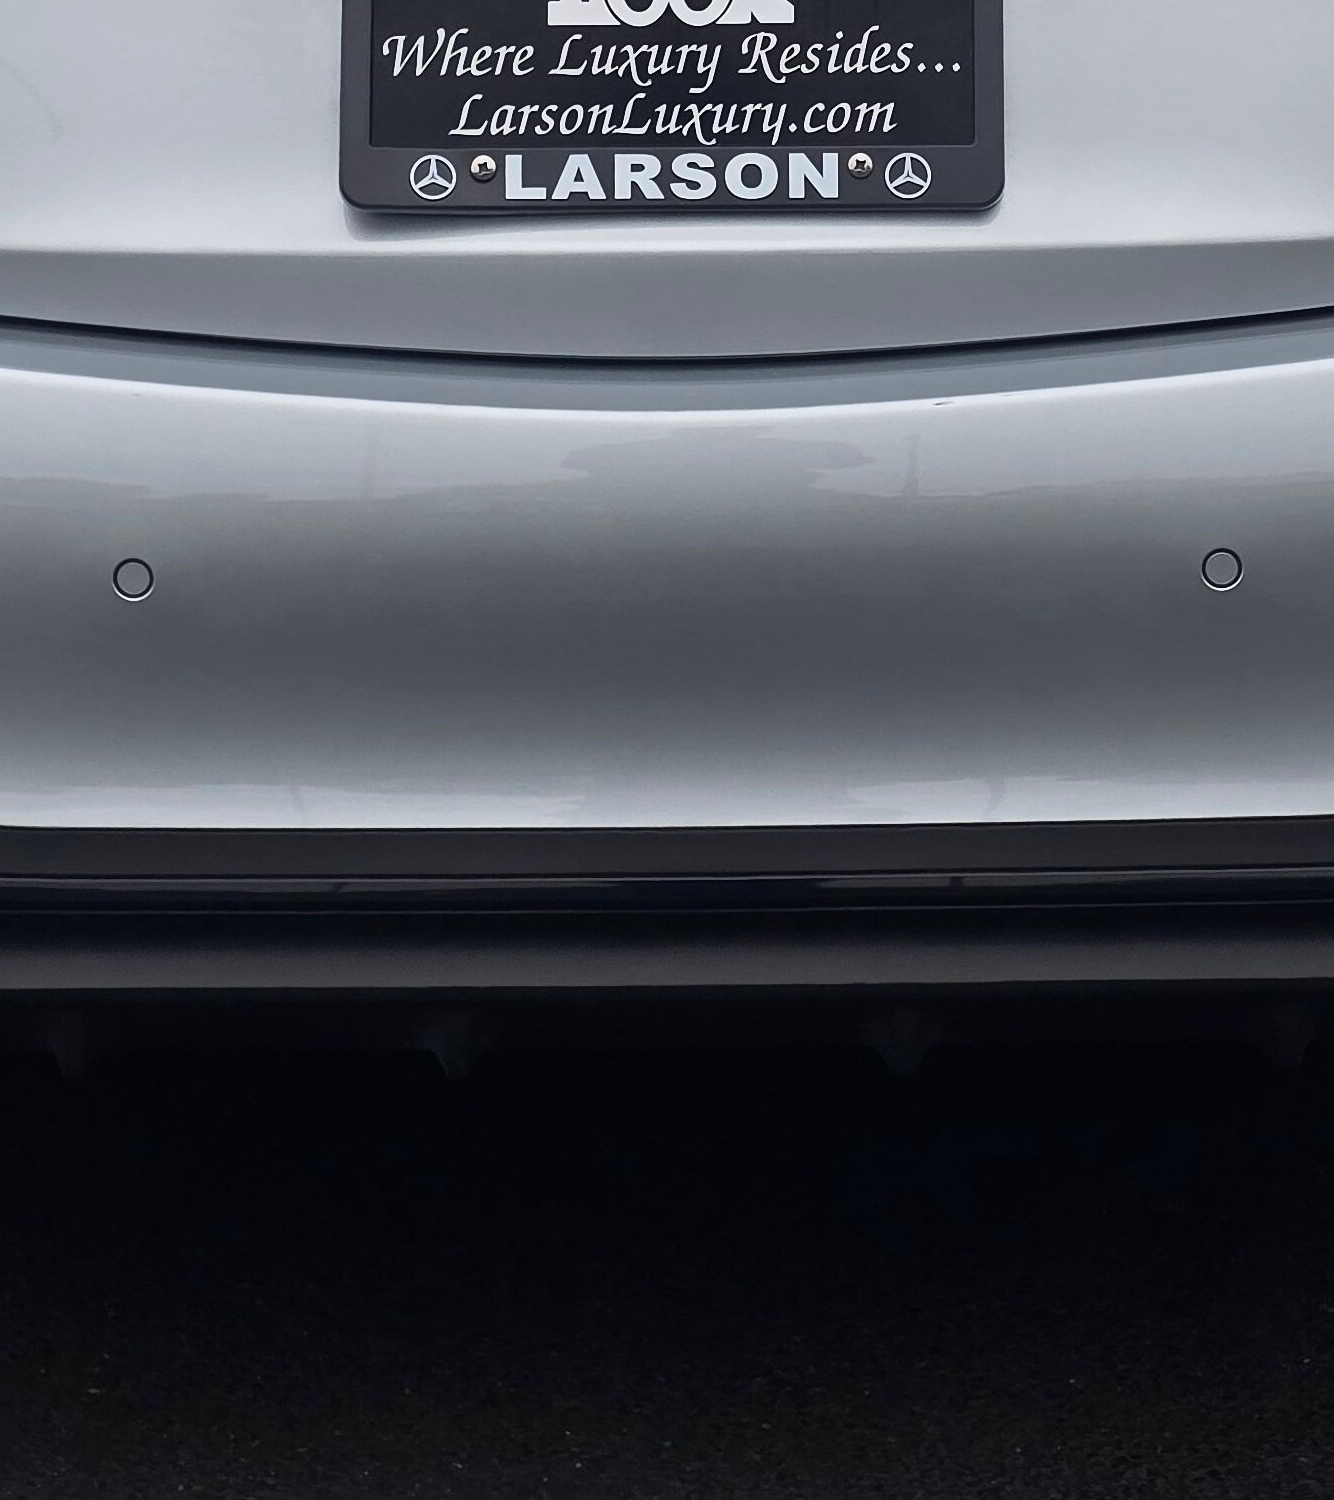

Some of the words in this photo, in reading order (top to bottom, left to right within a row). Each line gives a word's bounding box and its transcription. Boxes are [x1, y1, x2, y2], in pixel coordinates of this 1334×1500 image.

[381, 28, 535, 78] Where
[549, 33, 721, 93] Luxury
[739, 26, 963, 83] Resides...
[448, 94, 897, 145] LarsonLuxury.com
[504, 153, 840, 200] LARSON
